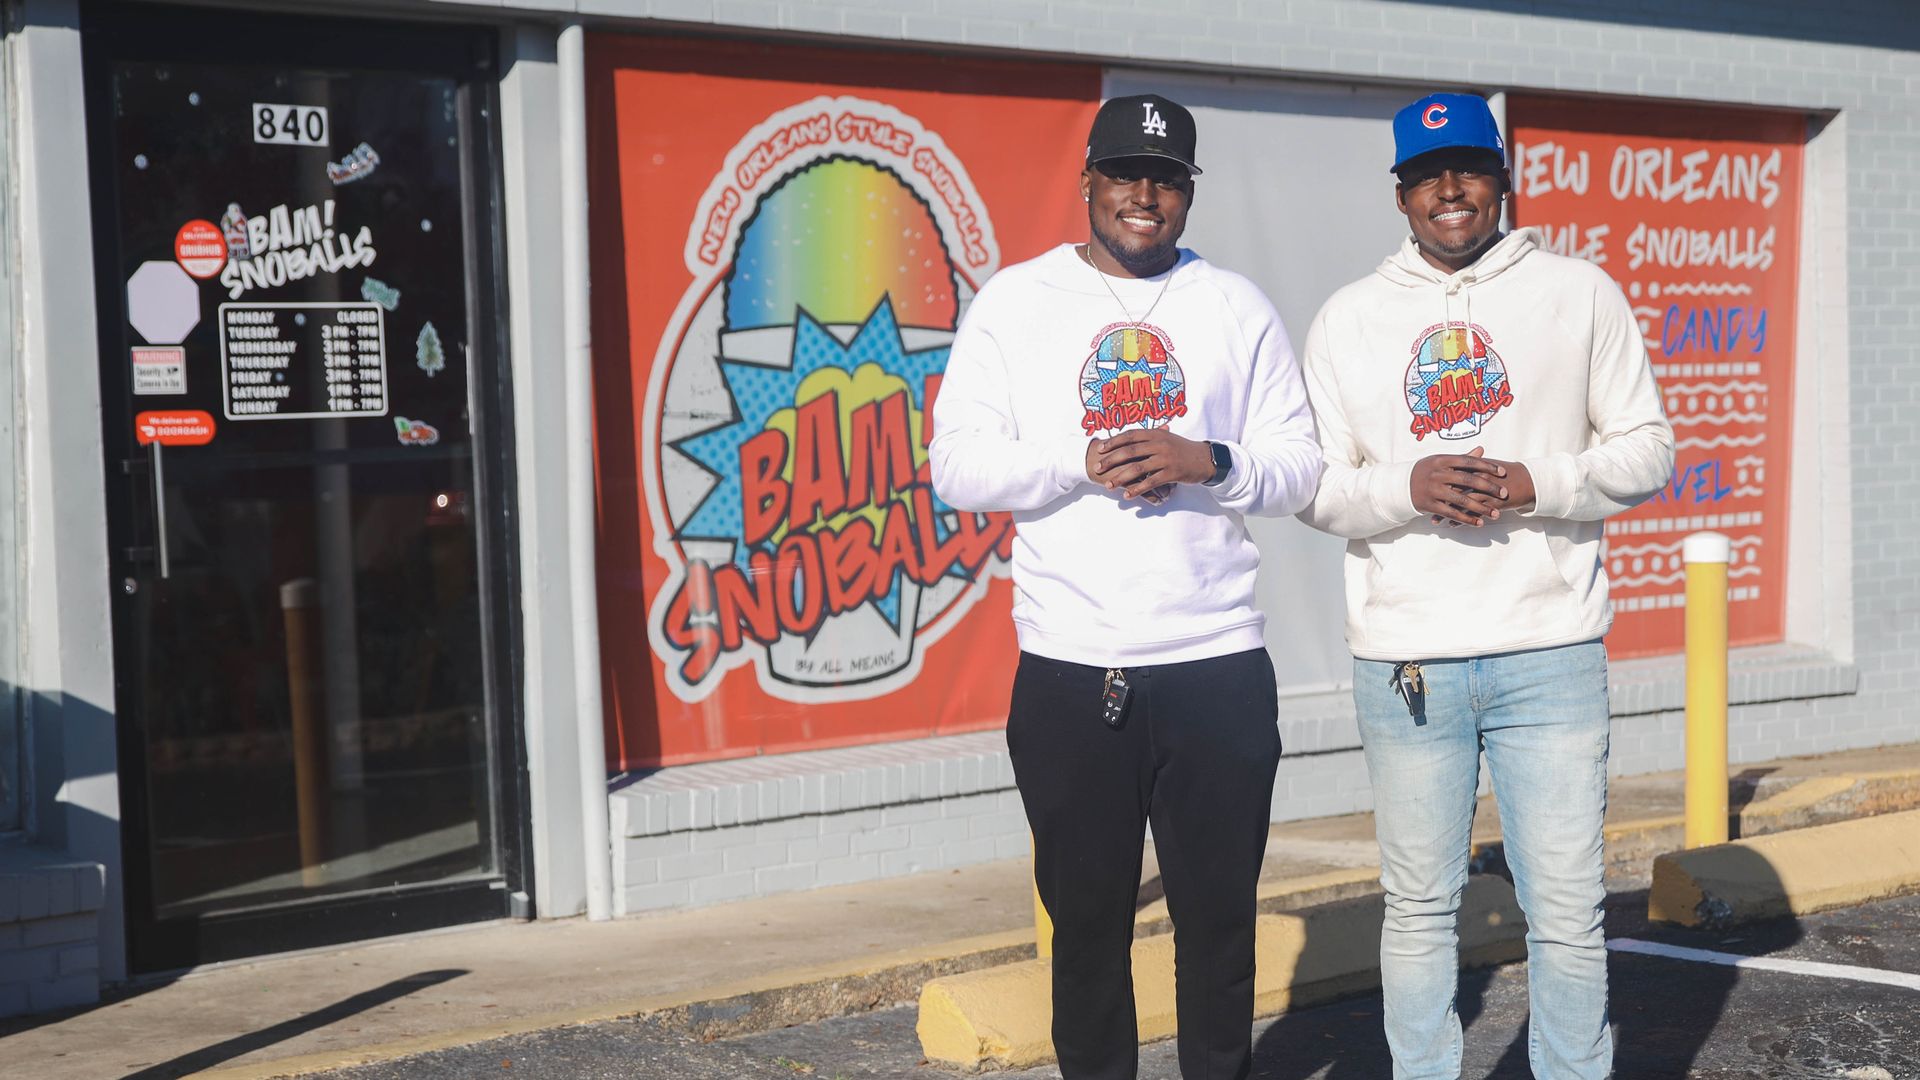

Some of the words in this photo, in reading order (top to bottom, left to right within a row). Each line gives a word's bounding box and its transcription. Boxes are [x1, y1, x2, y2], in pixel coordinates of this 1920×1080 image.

[258, 107, 324, 143] 840
[1142, 103, 1167, 137] LA
[1422, 103, 1449, 130] C
[698, 188, 741, 266] NEW
[736, 113, 831, 190] ORLEANS
[835, 112, 914, 157] STYLE
[913, 147, 989, 268] SNOBALLS
[1609, 144, 1782, 209] ORLEANS
[247, 200, 337, 257] BAM!
[219, 225, 377, 300] SNOBALLS
[1625, 222, 1776, 272] SNOBALLS
[227, 311, 275, 325] MONDAY
[337, 310, 378, 323] CLOSED
[228, 326, 280, 339] TUESDAY
[1661, 303, 1768, 357] CANDY
[229, 341, 298, 354] WEDNESDAY
[230, 355, 290, 369] THURSDAY
[231, 371, 272, 384] FRIDAY
[232, 386, 291, 399] SATURDAY
[1101, 373, 1163, 409] BAM!
[1426, 367, 1484, 411] BAM!
[232, 401, 278, 414] SUNDAY
[1081, 391, 1188, 436] SNOBALLS
[1410, 380, 1514, 441] SNOBALLS
[663, 484, 1014, 686] SNOBALL
[794, 659, 814, 672] BY
[819, 660, 841, 673] ALL
[849, 649, 894, 672] MEANS
